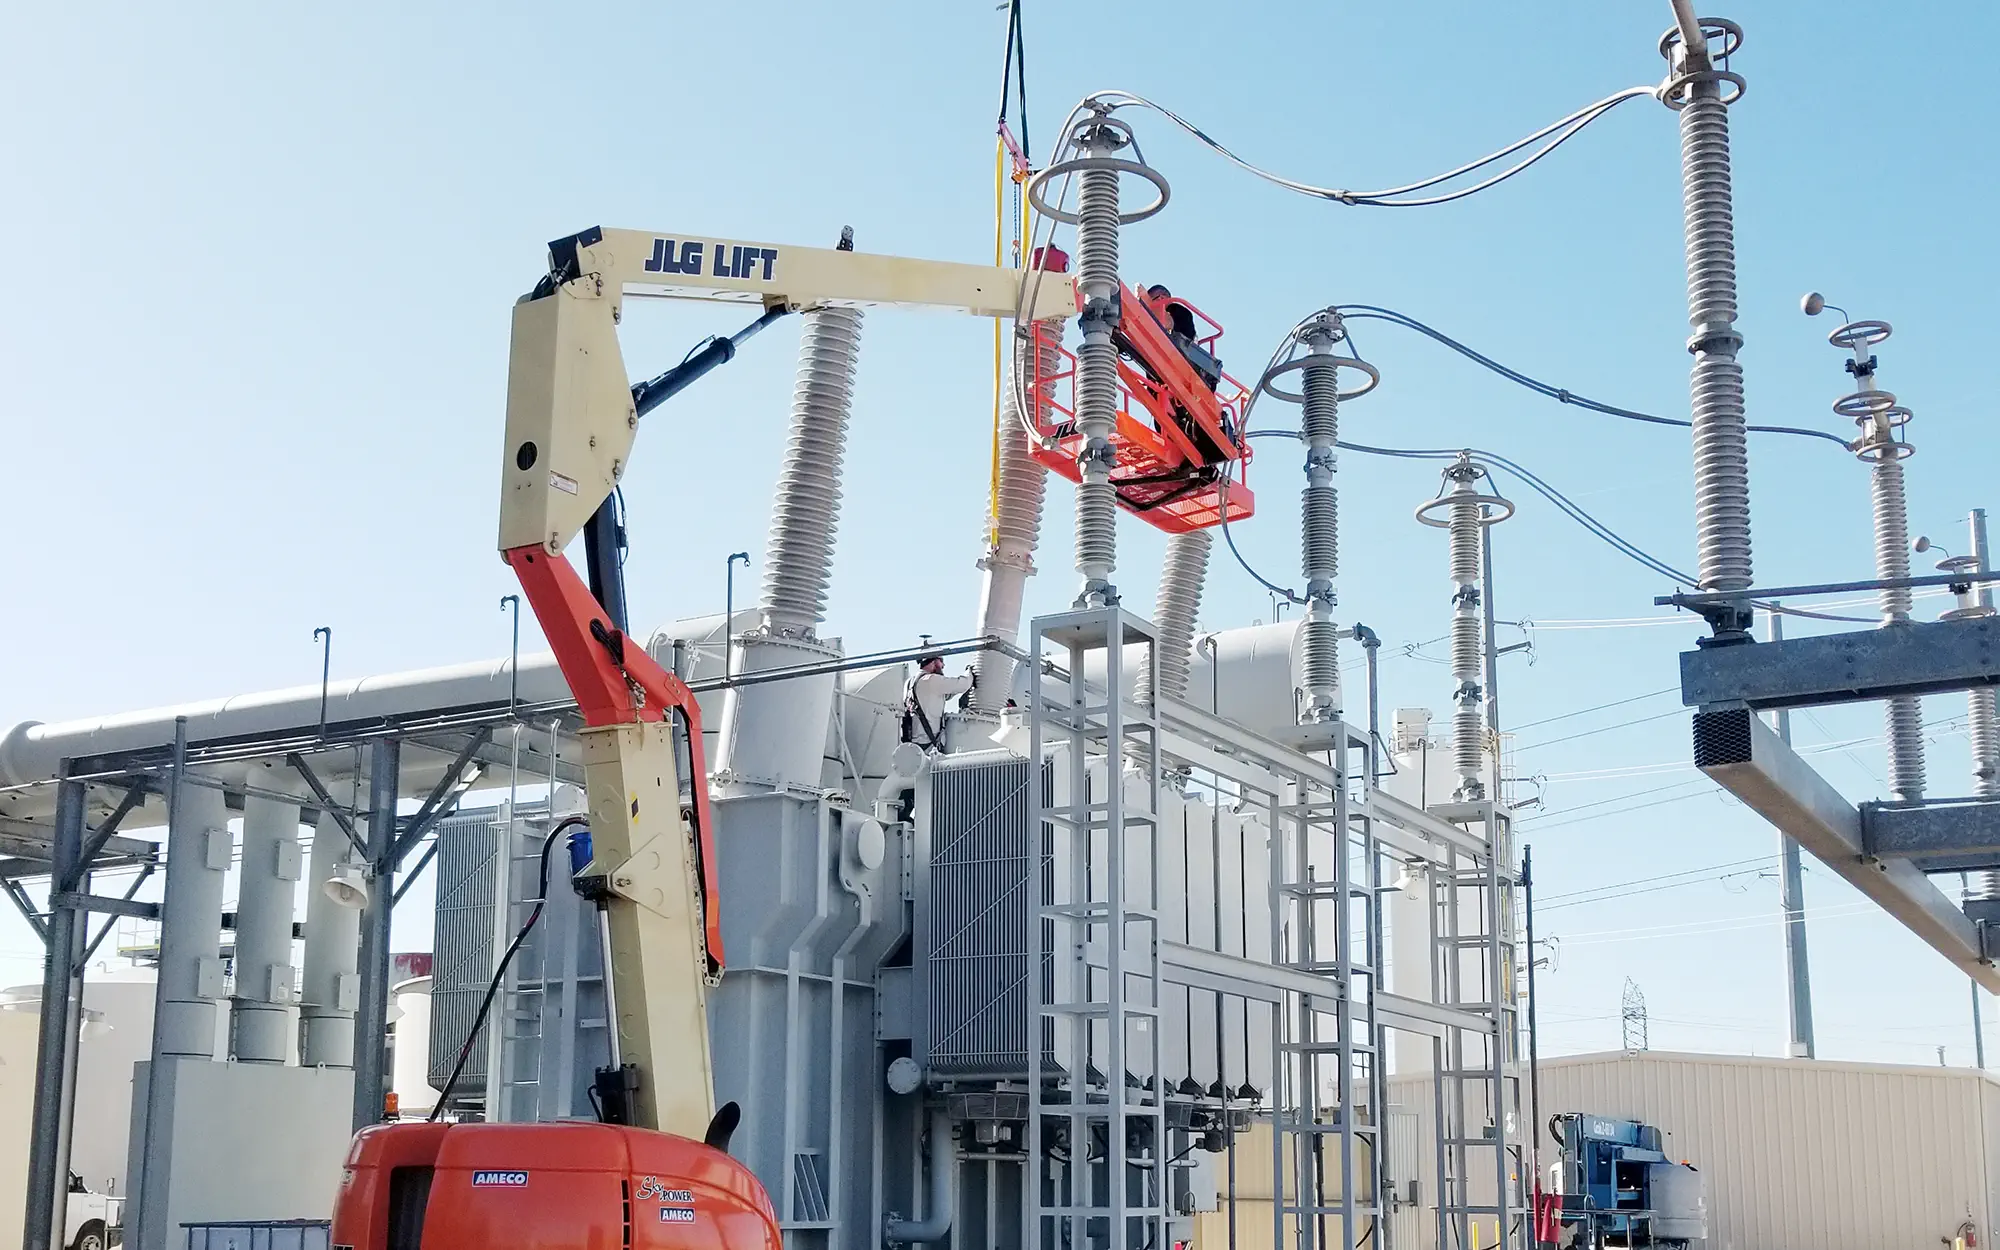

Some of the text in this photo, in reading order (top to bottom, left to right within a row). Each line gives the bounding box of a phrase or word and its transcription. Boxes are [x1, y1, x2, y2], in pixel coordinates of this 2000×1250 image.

[644, 238, 778, 281] JLG LIFT
[475, 1173, 526, 1185] AMECO
[637, 1176, 693, 1202] Sky POWER
[662, 1209, 694, 1221] AMECO
